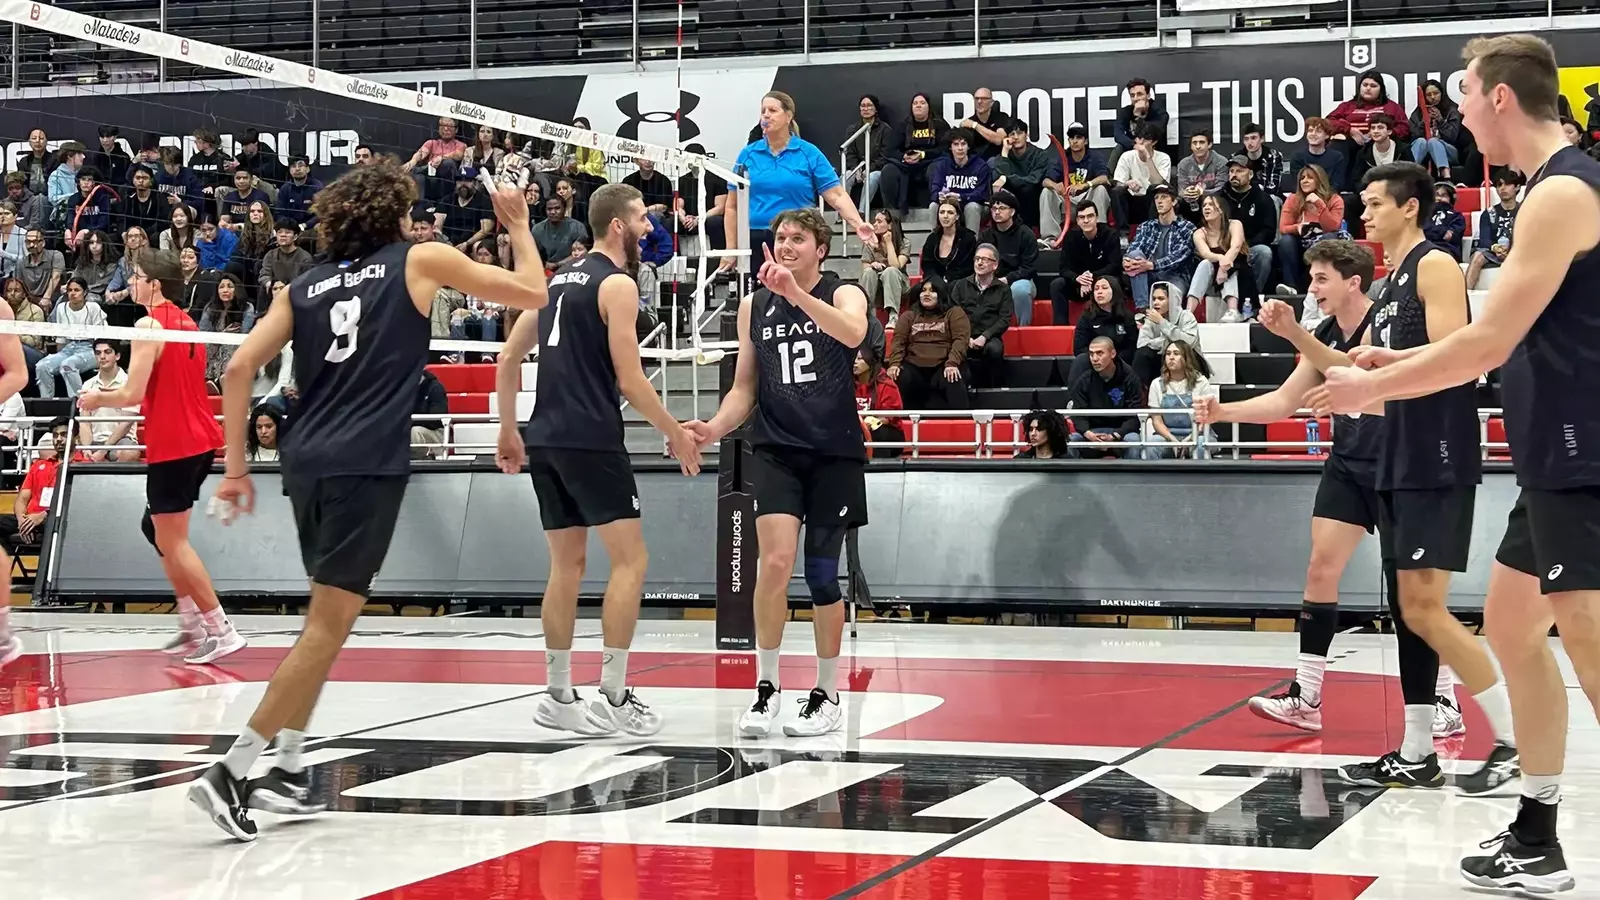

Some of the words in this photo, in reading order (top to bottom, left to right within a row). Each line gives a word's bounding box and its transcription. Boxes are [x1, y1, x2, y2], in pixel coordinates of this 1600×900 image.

[1351, 44, 1370, 65] 8
[942, 82, 1191, 151] POTET
[1202, 77, 1305, 145] THIS
[307, 274, 342, 299] LONG
[344, 263, 386, 288] BEACH
[777, 339, 817, 384] 12
[731, 510, 743, 547] sports
[730, 547, 742, 593] imports
